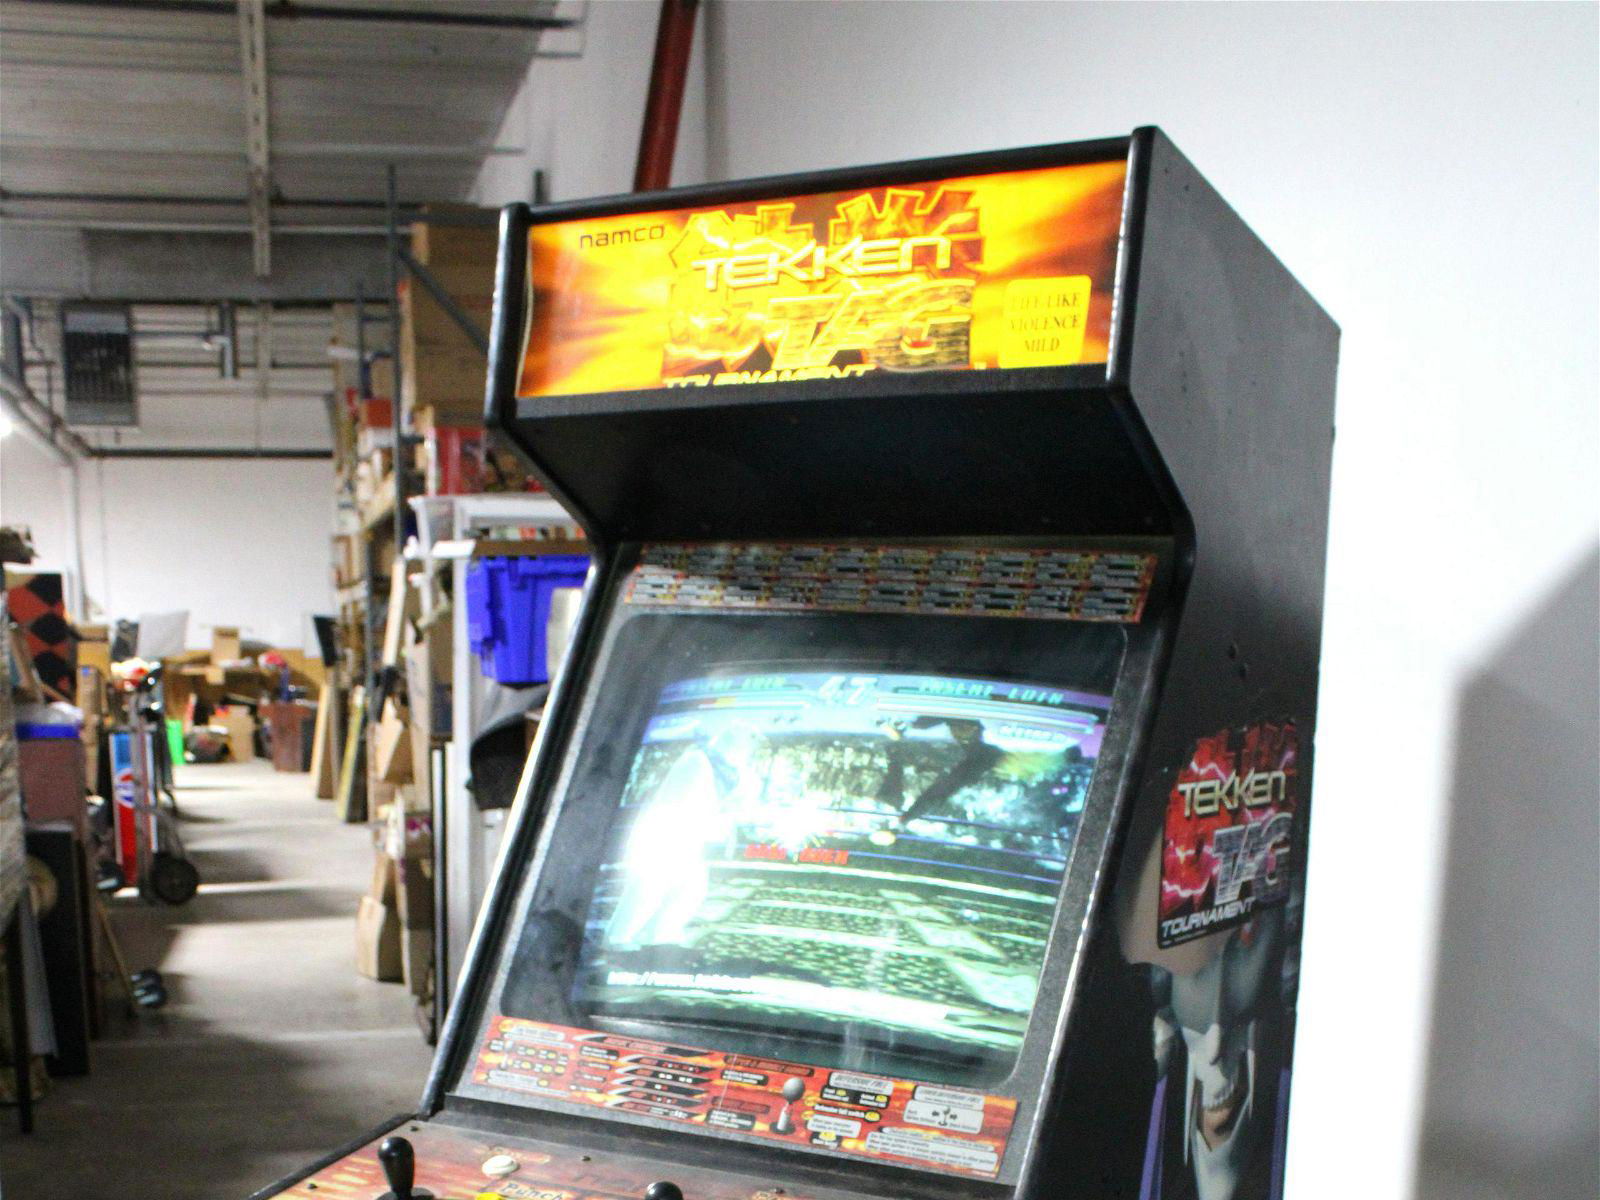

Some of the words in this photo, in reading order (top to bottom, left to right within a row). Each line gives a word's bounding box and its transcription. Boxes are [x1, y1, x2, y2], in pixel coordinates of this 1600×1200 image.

[580, 225, 665, 248] namco
[692, 236, 951, 292] TEKKEN
[1178, 767, 1286, 817] TEKKEN
[1161, 897, 1255, 938] TOURNAMENT
